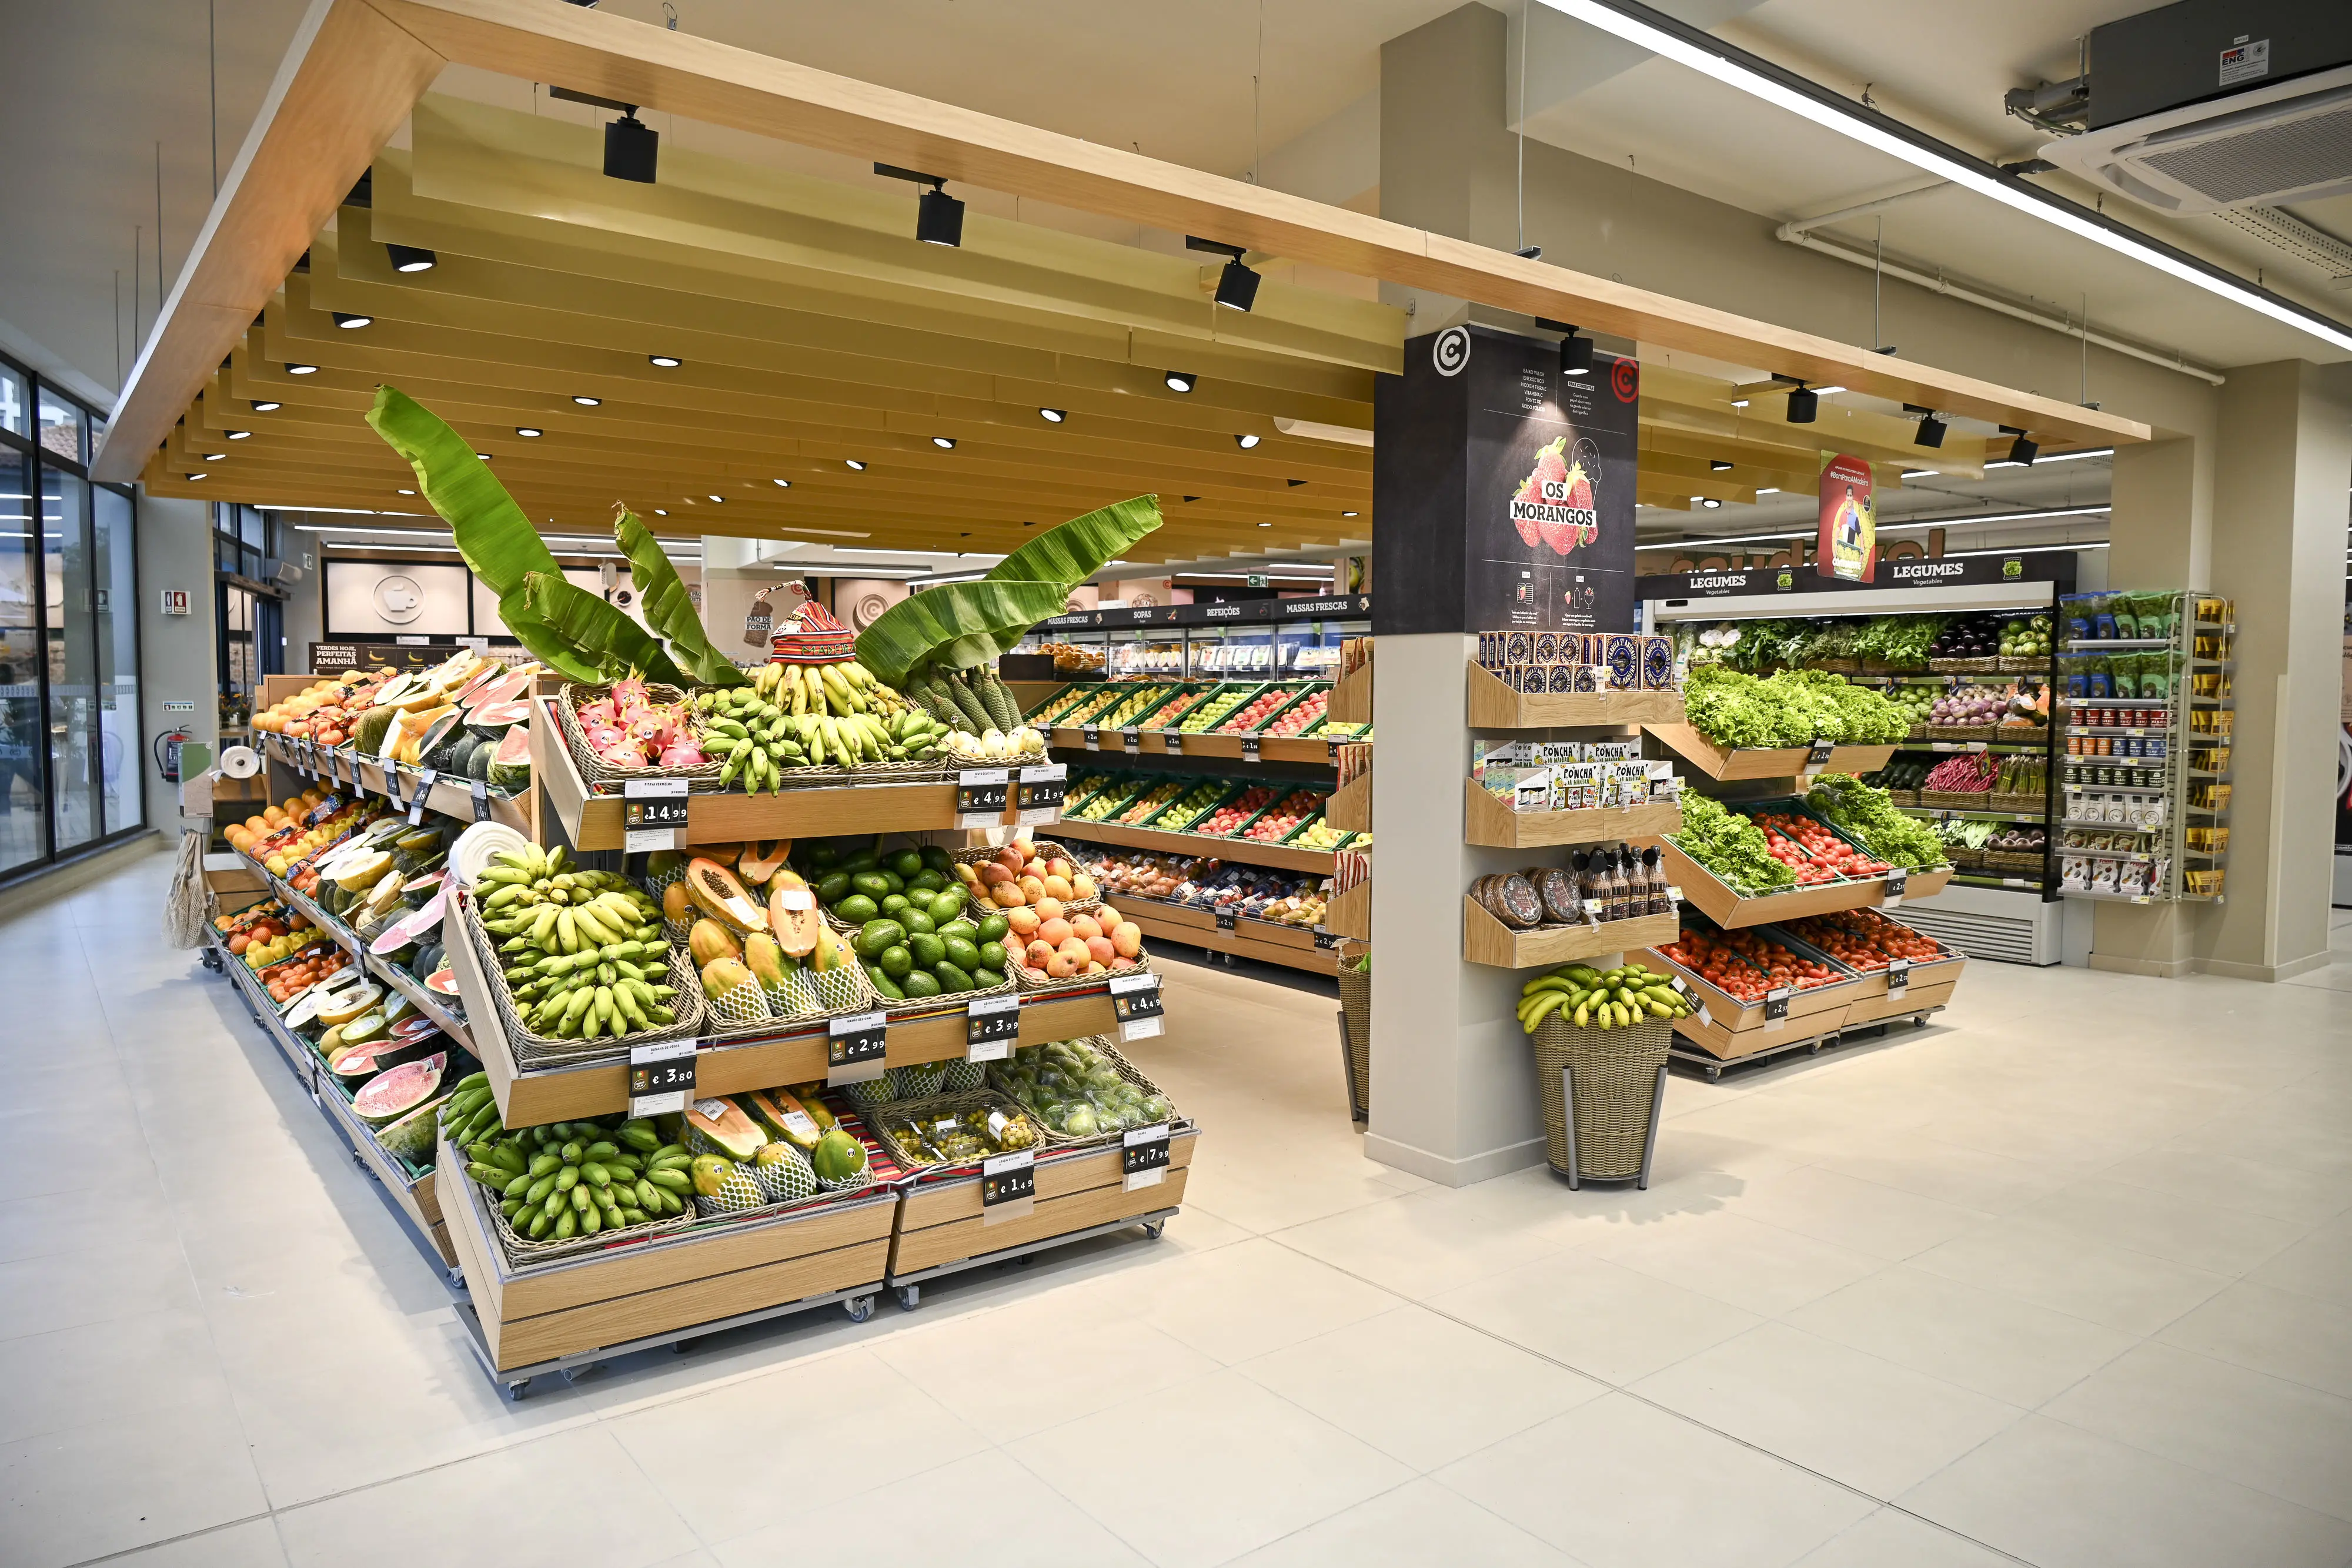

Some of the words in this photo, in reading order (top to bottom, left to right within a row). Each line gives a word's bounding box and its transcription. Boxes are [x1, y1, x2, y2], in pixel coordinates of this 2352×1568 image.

[2222, 55, 2244, 66] ENG
[1523, 375, 1545, 384] ENERGÉTICO
[1830, 471, 1869, 486] #BomParaAMadeira
[1546, 482, 1563, 499] OS
[1514, 502, 1593, 526] MORANGOS
[1893, 563, 1963, 578] LEGUMES
[1690, 575, 1746, 589] LEGUMES
[1207, 606, 1240, 618] REFEIÇÕES
[1287, 603, 1314, 613] MASSAS
[1316, 601, 1347, 611] FRESCAS
[1067, 616, 1088, 624] FRESCAS
[1134, 610, 1152, 619] SOPAS
[801, 642, 856, 656] MADEIRA
[316, 657, 357, 665] AMANHÃ
[1544, 746, 1573, 757] PONCHA
[1596, 747, 1623, 757] PONCHA
[1564, 768, 1593, 780] PONCHA
[1616, 765, 1644, 777] PONCHA
[984, 791, 1005, 804] 4,99
[1044, 788, 1064, 800] 1,99
[1140, 997, 1160, 1009] 4,49
[995, 1019, 1018, 1032] 3,99
[848, 1047, 854, 1055] €
[860, 1038, 884, 1052] 2,99
[652, 1075, 659, 1084] €
[667, 1068, 693, 1082] 3,80
[1150, 1148, 1169, 1161] 7,99
[1000, 1185, 1006, 1193] €
[1011, 1178, 1033, 1191] 1,49
